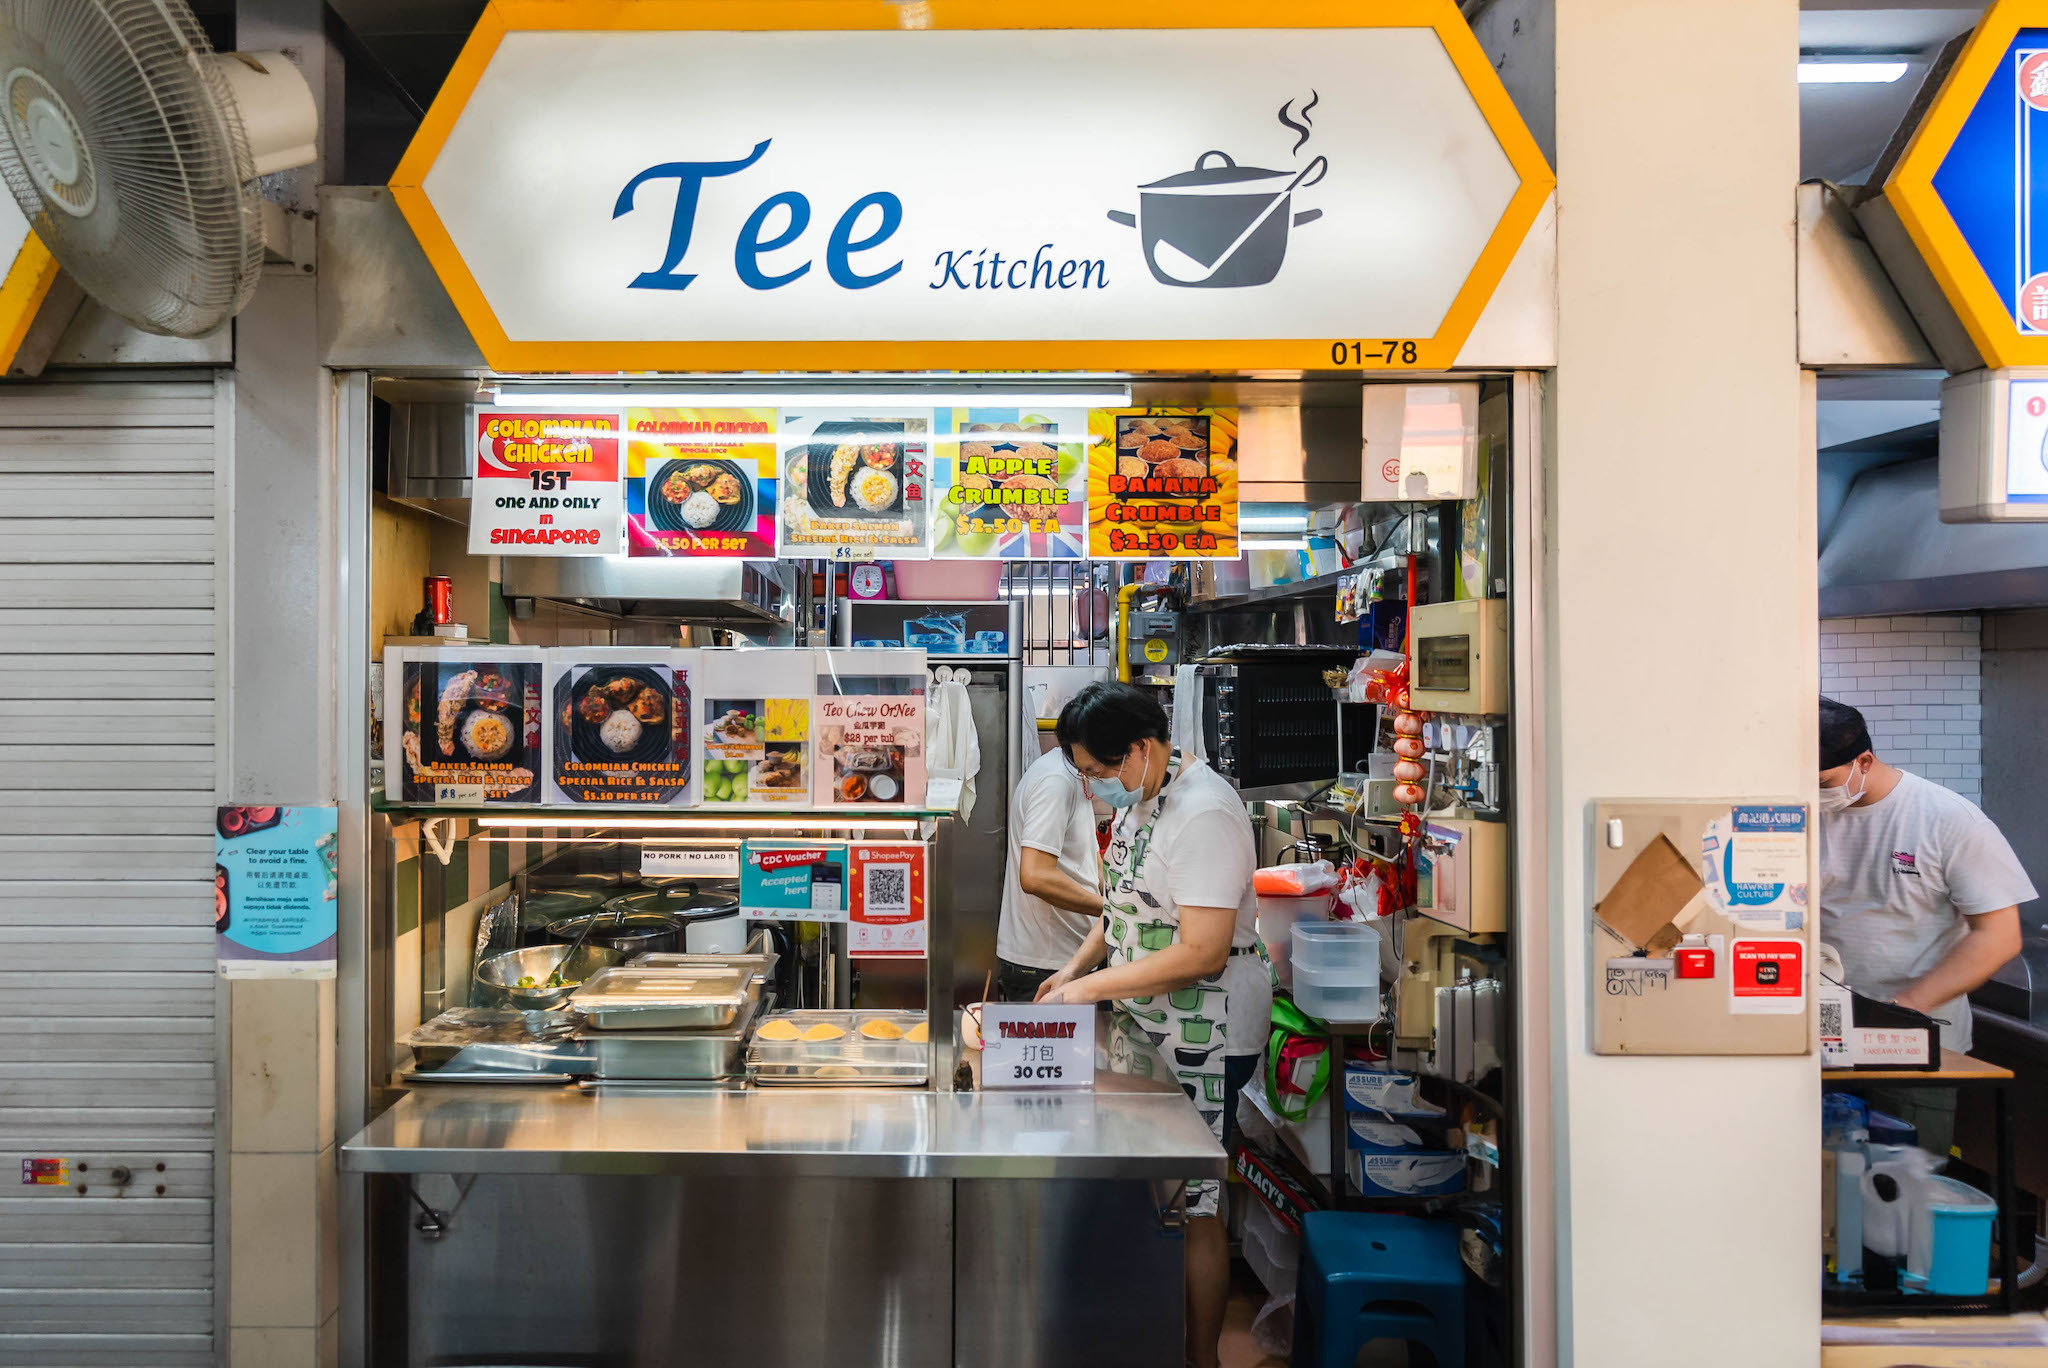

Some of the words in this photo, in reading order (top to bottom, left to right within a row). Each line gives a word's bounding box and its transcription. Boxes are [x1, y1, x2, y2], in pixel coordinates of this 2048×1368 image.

[612, 138, 904, 290] Tee
[929, 244, 1110, 290] Kitchen
[966, 456, 1052, 475] APPLE
[529, 470, 571, 491] 1ST
[1108, 474, 1218, 494] BANANA
[948, 485, 1069, 505] CRUMBLE
[1105, 502, 1221, 522] CRUMBLE
[956, 513, 1023, 535] $2.50
[1029, 518, 1060, 534] EA
[1110, 528, 1179, 552] $2.50
[1183, 533, 1218, 550] EA
[823, 702, 843, 717] Teo
[844, 732, 861, 743] $28
[863, 735, 878, 744] per
[881, 734, 895, 743] tub
[431, 761, 469, 771] BAKED
[470, 762, 513, 771] SALMON
[564, 762, 629, 771] COLOMBIAN
[631, 762, 680, 771] CHICKEN
[413, 775, 456, 784] SPECIAL
[458, 775, 482, 784] RICE
[497, 776, 531, 785] SALSA
[559, 776, 605, 785] SPECIAL
[607, 776, 632, 785] RICE
[649, 776, 685, 786] SALSA
[583, 790, 613, 800] $5.50
[640, 792, 660, 800] SET
[762, 855, 783, 865] CDC
[784, 851, 822, 862] Voucher
[871, 851, 915, 861] ShopeePay
[760, 874, 808, 887] Accepted
[784, 886, 808, 895] here
[999, 1022, 1077, 1039] TAKEAWAY
[1022, 1045, 1054, 1061] 打包
[1014, 1066, 1033, 1078] 30
[1036, 1066, 1063, 1078] CTS
[1349, 1075, 1383, 1084] ASSURE
[1246, 1163, 1285, 1209] LACY'S
